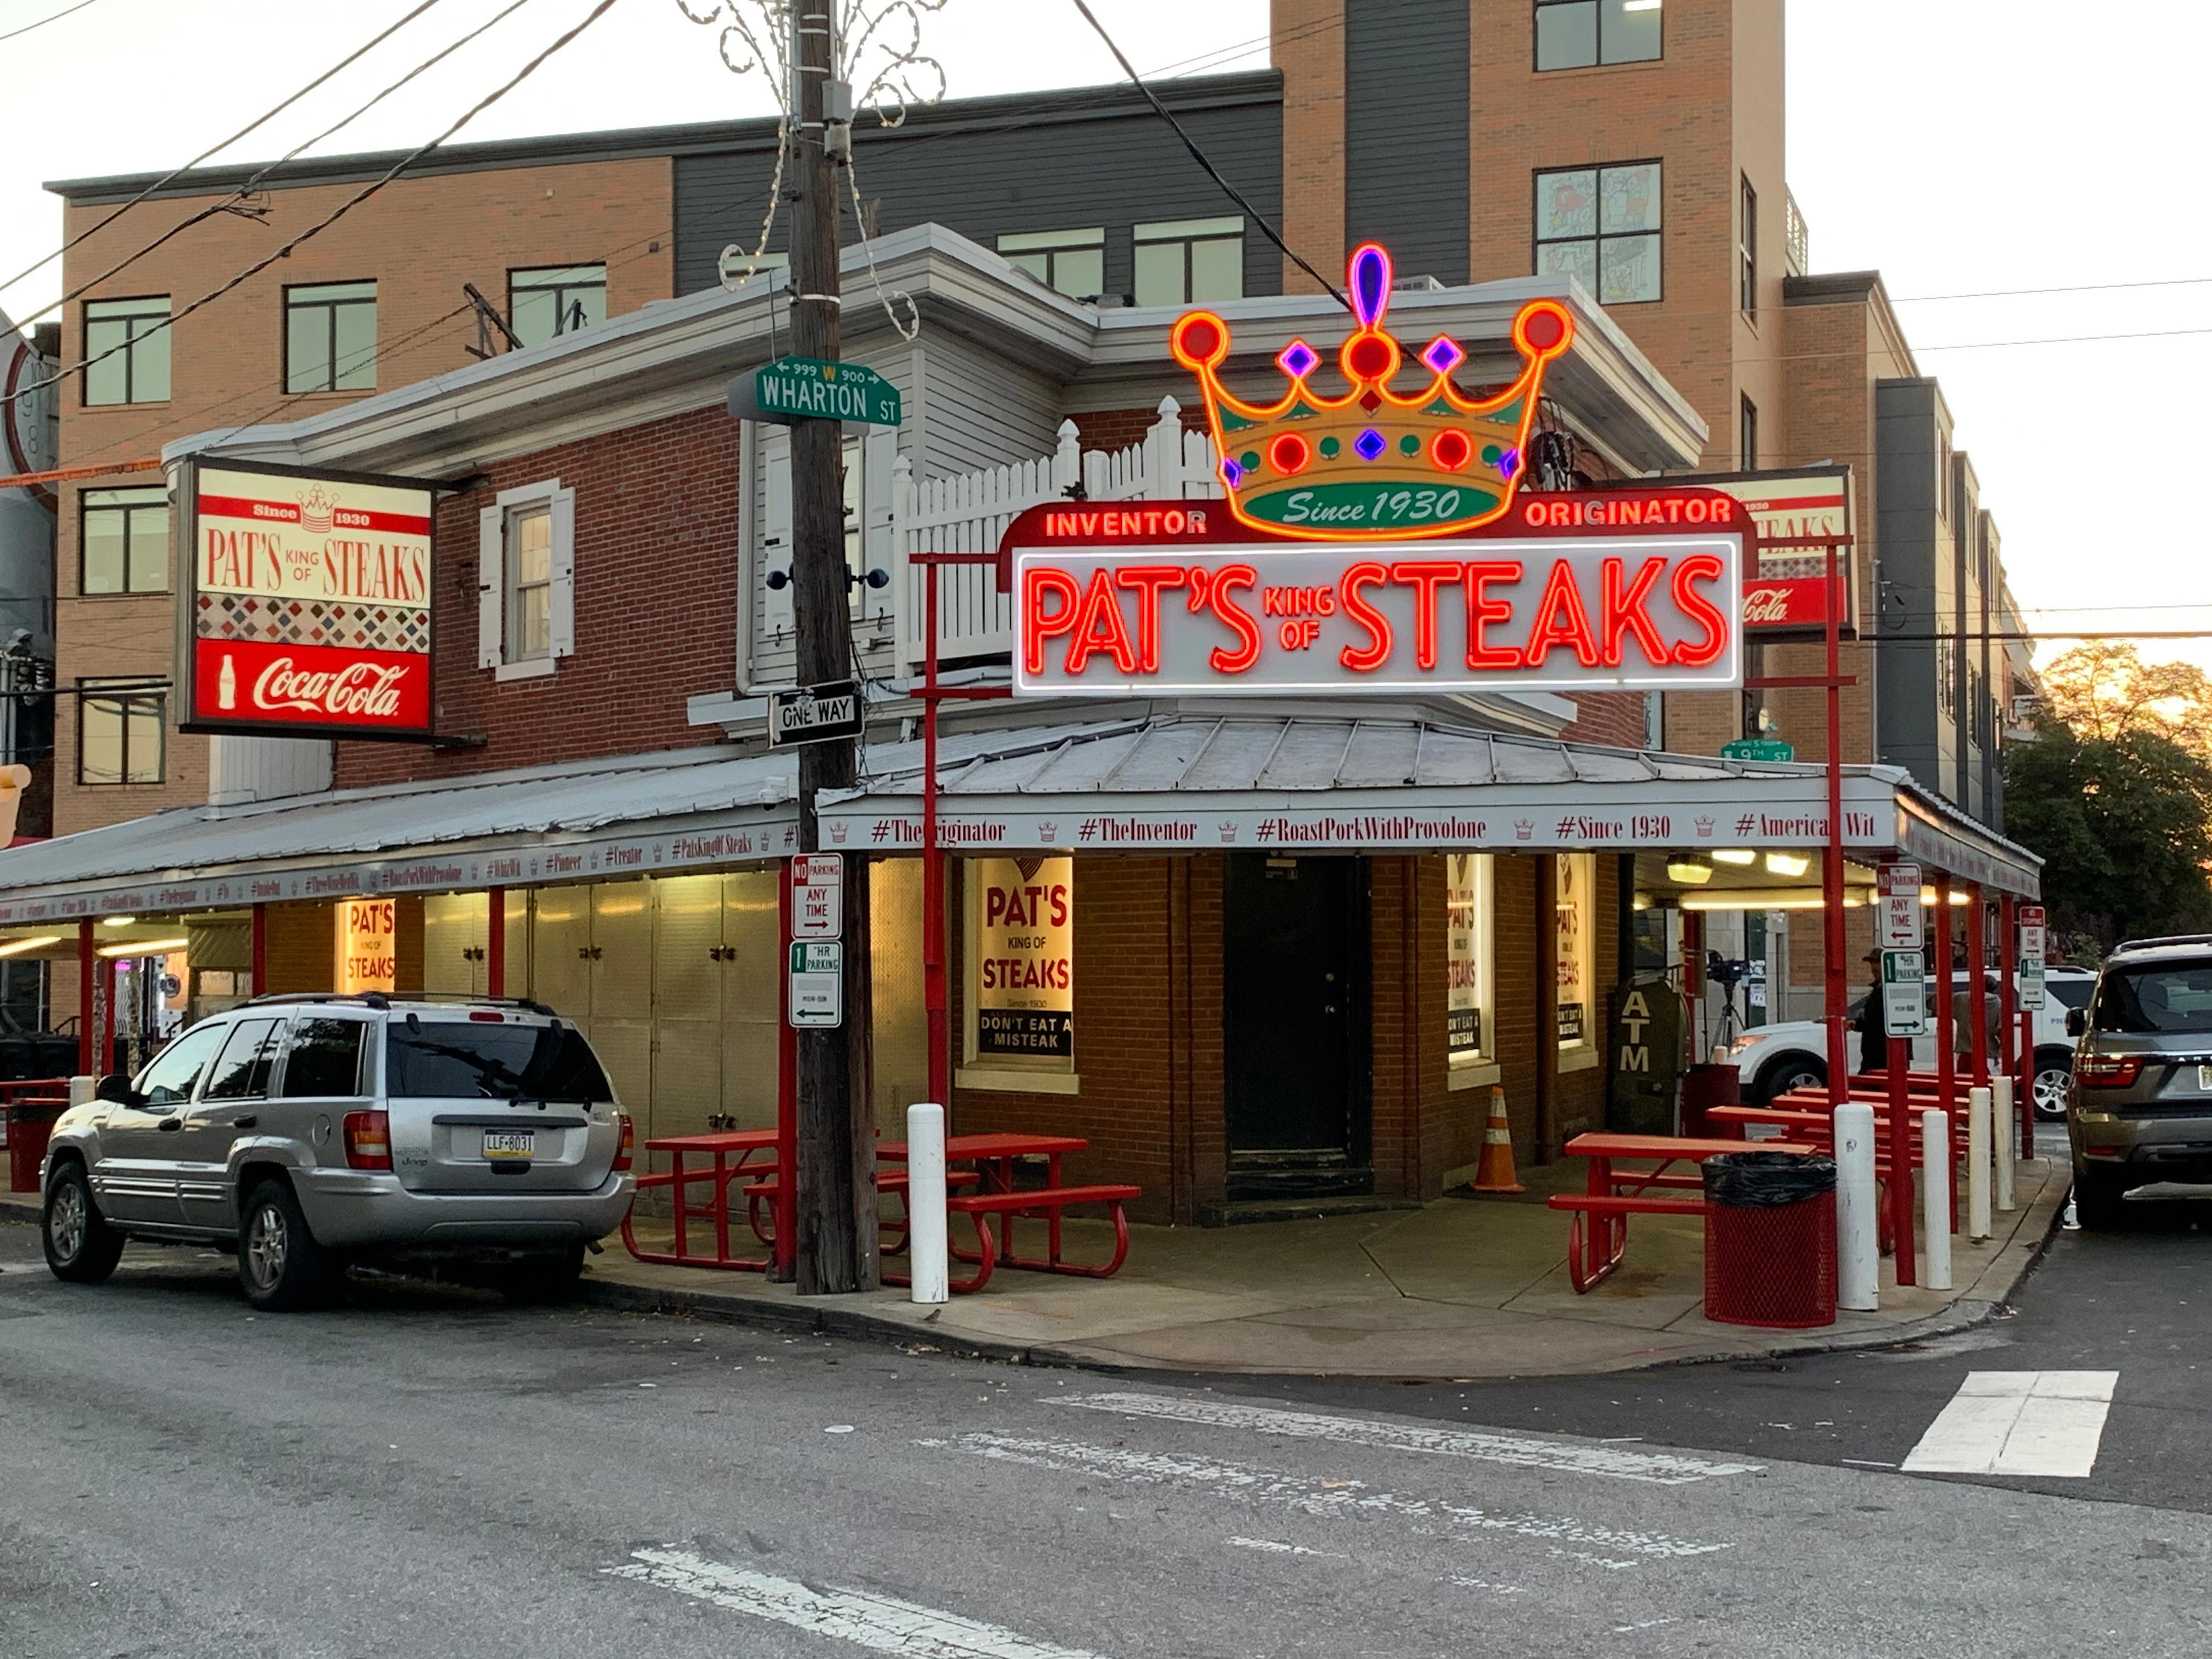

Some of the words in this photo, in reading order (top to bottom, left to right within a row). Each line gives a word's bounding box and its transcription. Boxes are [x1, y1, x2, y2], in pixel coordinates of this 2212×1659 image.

[793, 364, 817, 377] 999
[842, 370, 865, 383] 900
[763, 375, 866, 417] WHARTON
[880, 400, 896, 421] ST
[253, 504, 297, 519] Since
[335, 512, 370, 526] 1930
[1283, 491, 1366, 522] Since
[1371, 489, 1461, 521] 1930
[1525, 498, 1732, 527] ORIGINATOR
[1746, 502, 1769, 511] 1930
[1045, 510, 1207, 537] INVENTOR
[1757, 515, 1834, 554] TEAKS
[206, 528, 282, 591] PAT'S
[285, 549, 320, 566] KING
[293, 567, 312, 582] OF
[322, 538, 426, 603] STEAKS
[1264, 586, 1336, 617] KING
[1742, 588, 1794, 622] Cola
[1025, 562, 1262, 675] PAT'S
[1338, 556, 1729, 672] STEAKS
[1279, 620, 1321, 650] OF
[253, 657, 410, 716] Coca-Cola
[782, 703, 813, 728] ONE
[818, 698, 850, 722] WAY
[1774, 751, 1788, 761] ST
[871, 819, 1006, 846] #Theriginator
[1078, 817, 1198, 842] #TheInventor
[1255, 816, 1487, 842] #RoastPorkWithProvolone
[1555, 816, 1623, 840] #Since
[1630, 815, 1671, 839] 1930
[605, 846, 643, 866] #Creator
[794, 863, 807, 879] NO
[809, 865, 840, 876] PARKING
[1878, 874, 1890, 888] NO
[806, 889, 827, 901] ANY
[986, 884, 1067, 928] PAT'S
[1891, 899, 1909, 911] ANY
[350, 903, 393, 934] PAT'S
[806, 904, 828, 917] TIME
[1890, 914, 1912, 927] TIME
[1008, 937, 1031, 949] KING
[1034, 936, 1047, 949] OF
[348, 957, 395, 979] STEAKS
[796, 947, 802, 968] 1
[817, 946, 830, 957] HR
[807, 959, 838, 971] PARKING
[983, 958, 1069, 990] STEAKS
[981, 1016, 1024, 1031] DON'T
[1029, 1018, 1057, 1031] EAT
[1062, 1019, 1072, 1031] A
[1620, 991, 1650, 1073] ATM
[994, 1033, 1058, 1048] MISTEAK
